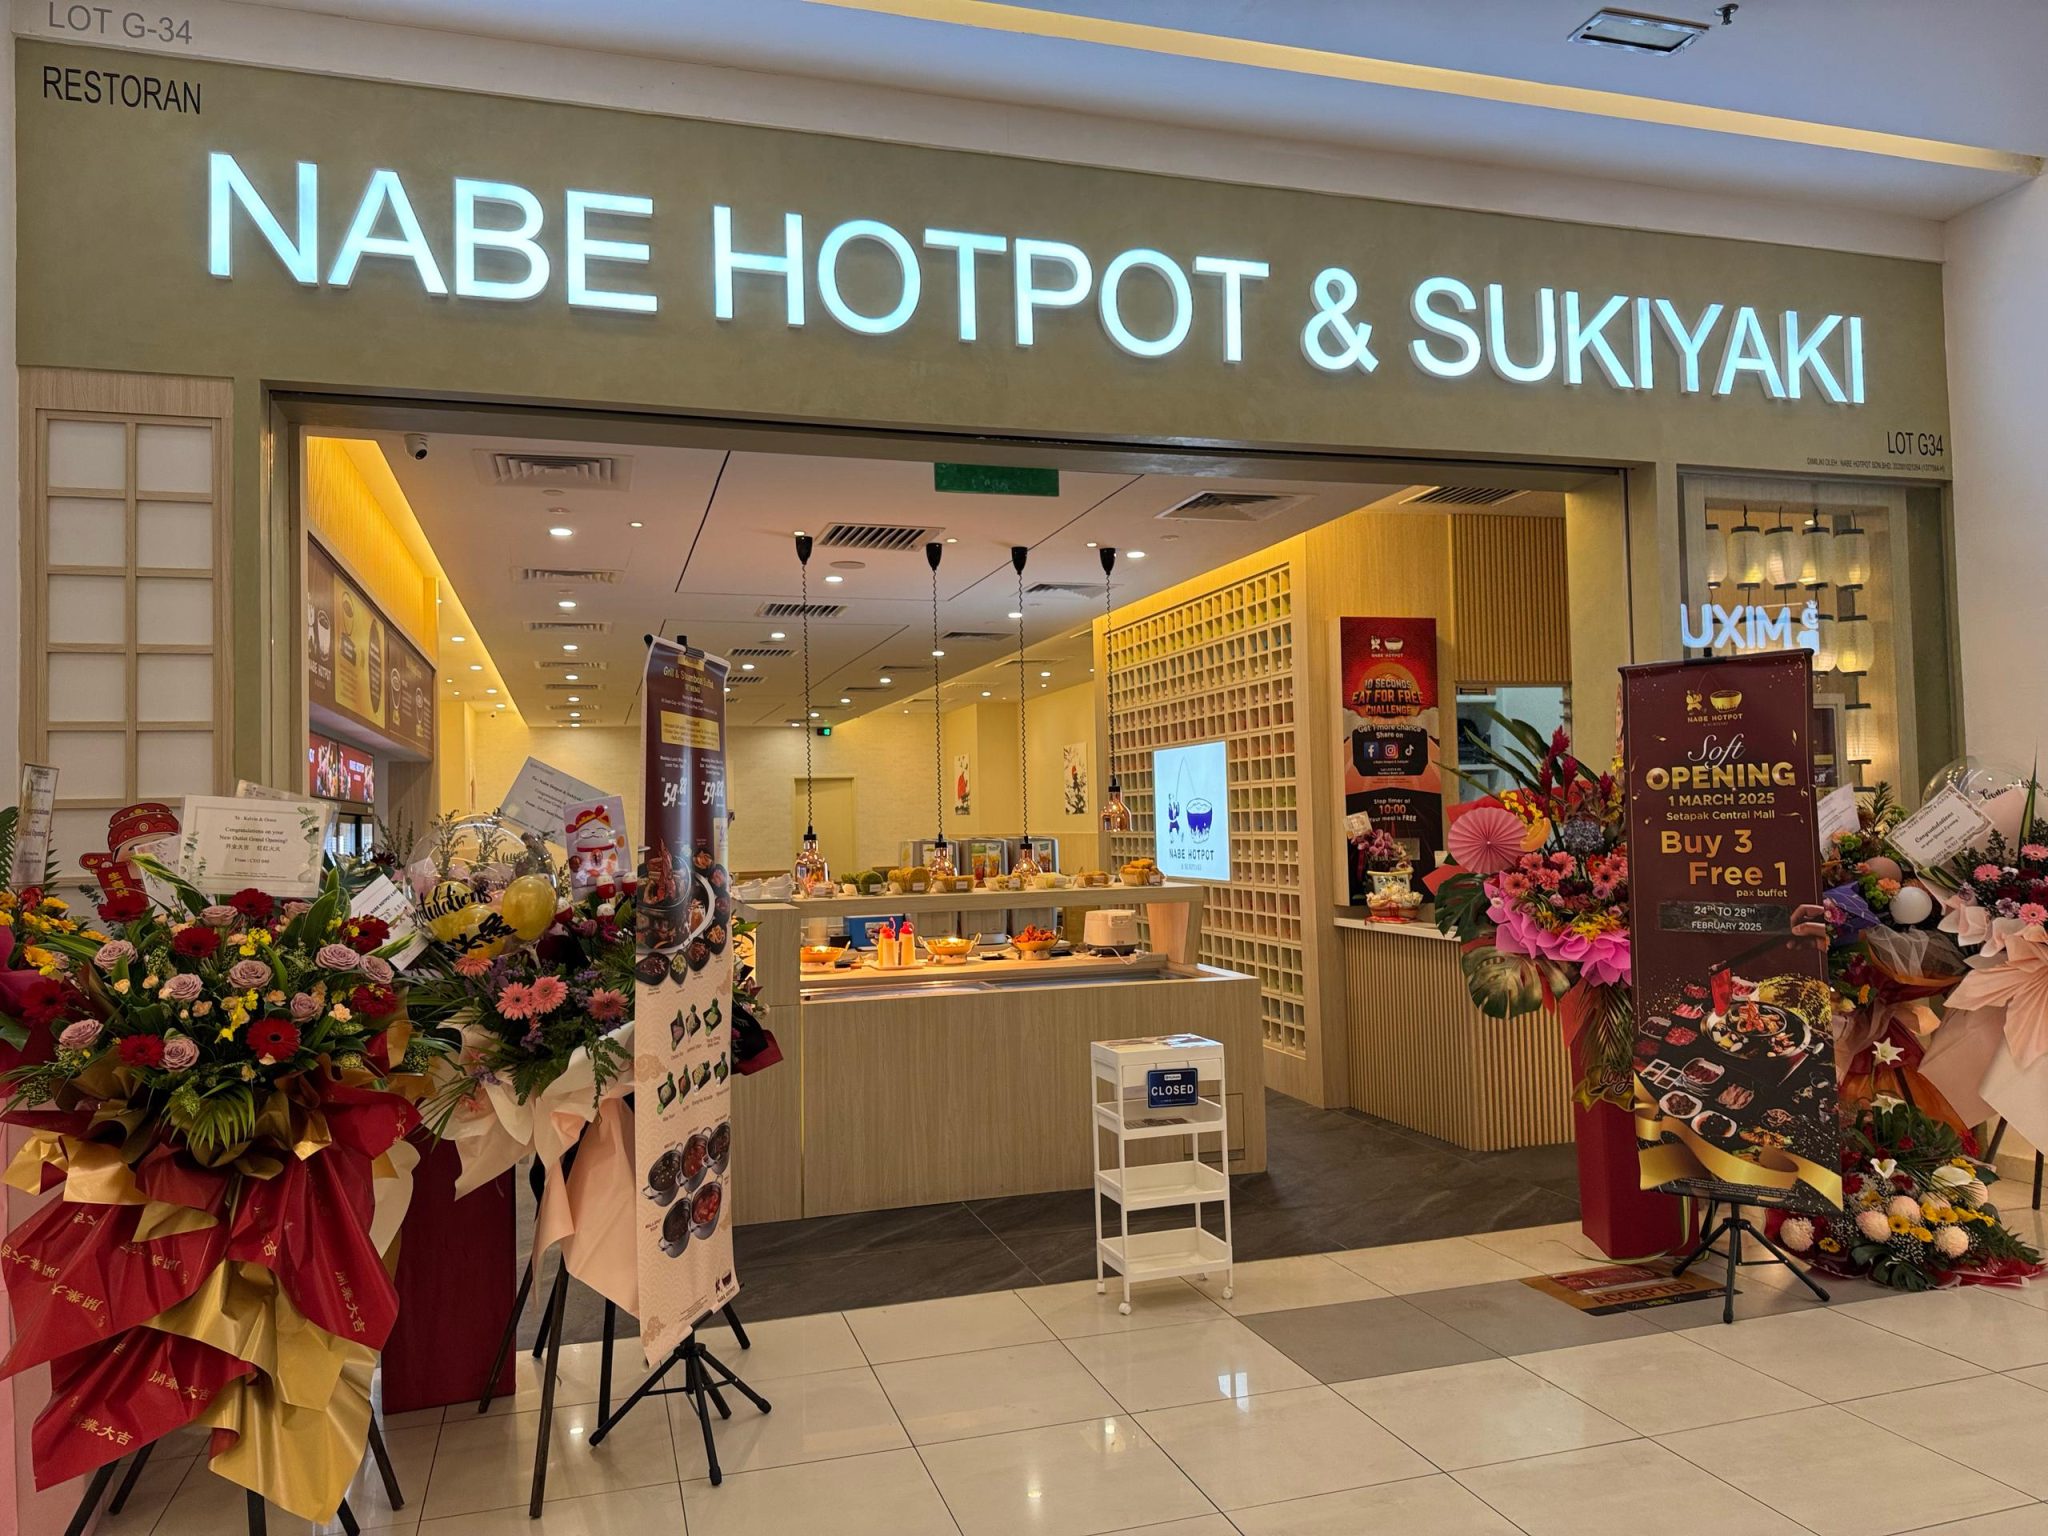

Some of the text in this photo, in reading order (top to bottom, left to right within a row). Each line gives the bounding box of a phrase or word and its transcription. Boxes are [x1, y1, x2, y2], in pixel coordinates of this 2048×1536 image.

[49, 2, 192, 45] LOT G-34
[43, 65, 201, 114] RESTORAN
[208, 151, 1865, 406] NABE HOTPOT & SUKIYAKI
[1887, 431, 1943, 456] LOT G34
[1365, 678, 1411, 688] 10 SECONDS
[1352, 689, 1424, 704] EAT FOR FREE
[1366, 704, 1411, 715] CHALLENGE
[1688, 713, 1743, 723] NABE HOTPOT
[1688, 733, 1746, 769] Soft
[1646, 761, 1796, 790] OPENING
[1668, 793, 1775, 806] 1 MARCH 2025
[1379, 804, 1406, 814] 10:00
[1666, 810, 1775, 822] Setapak Central Mall
[1914, 811, 1954, 844] Congratulations
[1661, 829, 1753, 858] Buy 3
[1169, 848, 1215, 861] NABE HOTPOT
[1689, 861, 1787, 886] Free 1
[1736, 888, 1788, 897] pax buffet
[1717, 906, 1732, 916] TO
[1692, 921, 1762, 931] FEBRUARY 2025
[1151, 1084, 1194, 1096] CLOSED
[1592, 1282, 1697, 1305] ACCEPTED
